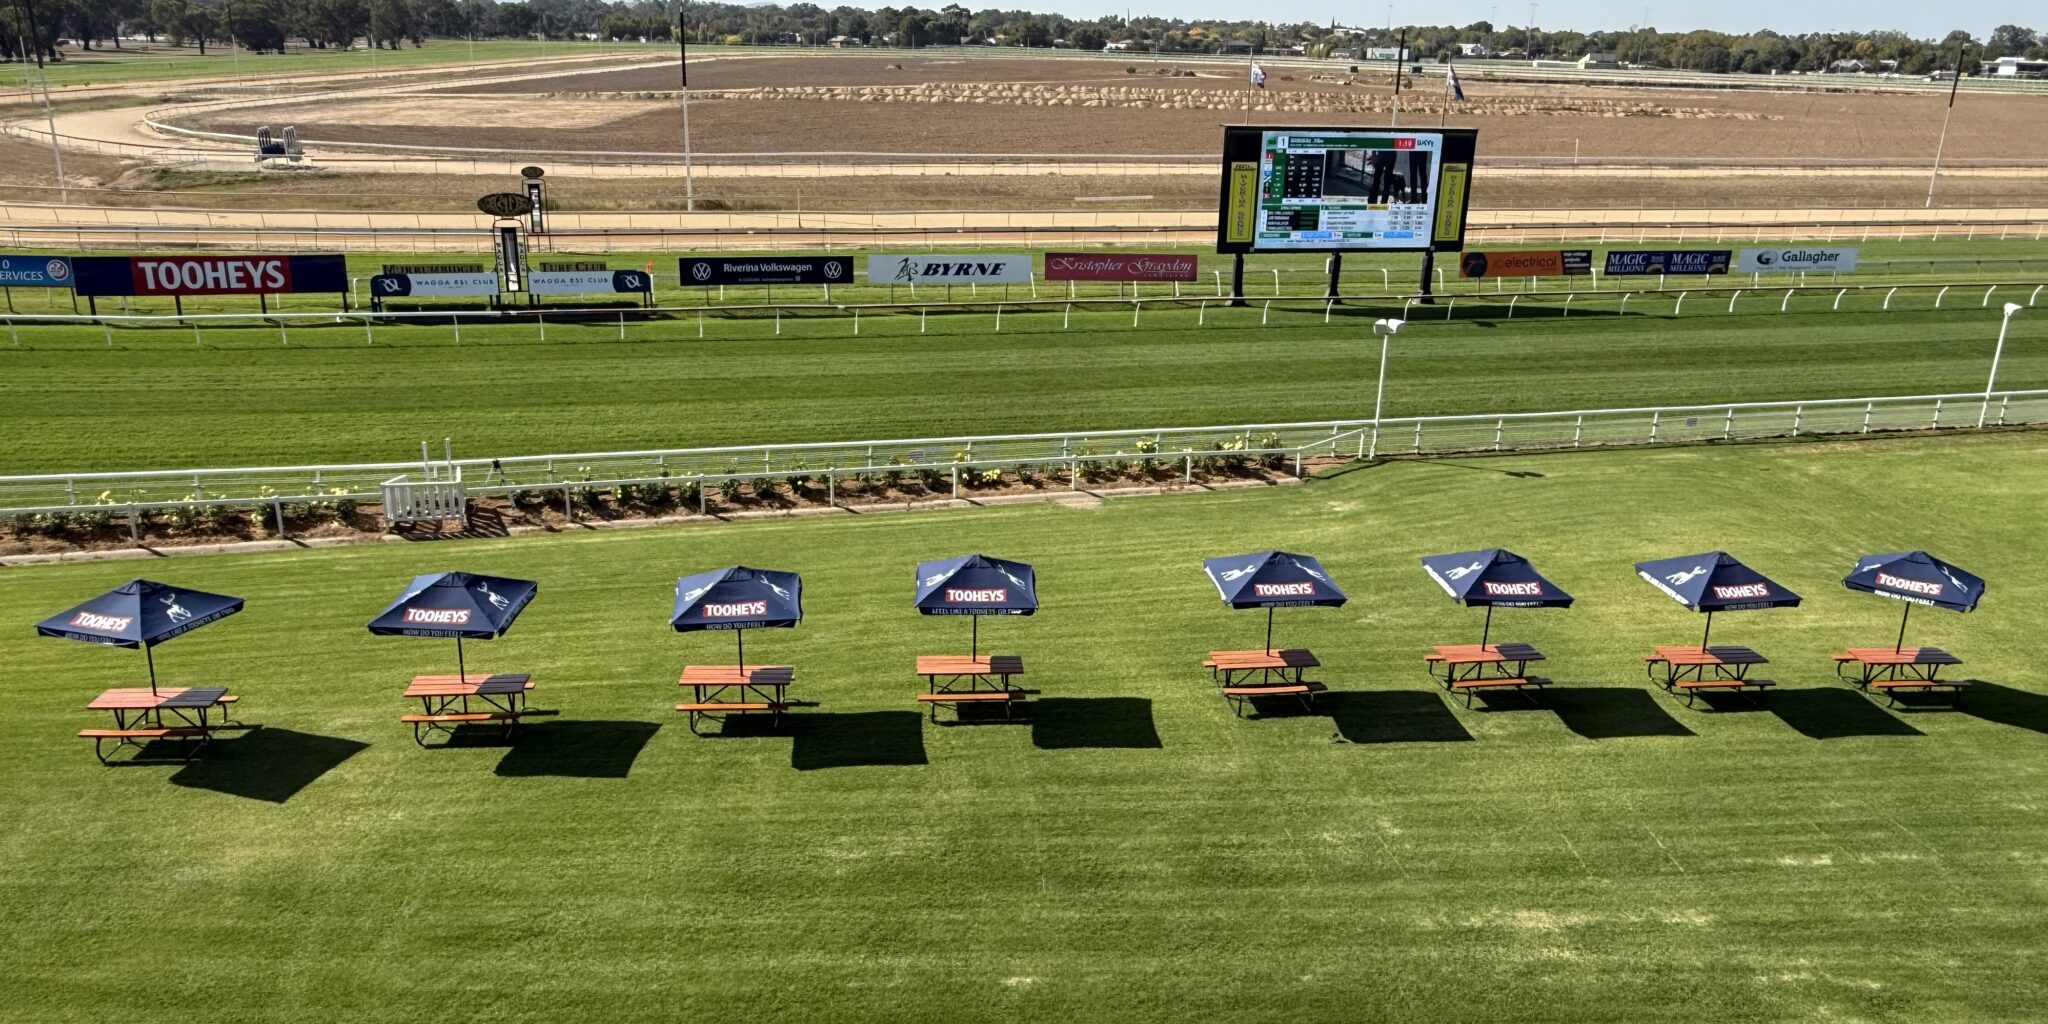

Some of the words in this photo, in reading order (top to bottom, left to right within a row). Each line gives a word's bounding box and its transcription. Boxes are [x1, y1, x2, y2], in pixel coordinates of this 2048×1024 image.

[1608, 254, 1648, 265] MAGIC
[1671, 253, 1710, 264] MAGIC
[1782, 250, 1840, 264] Gallagher
[723, 264, 758, 272] Riverina
[760, 263, 812, 273] Volkswagen
[921, 262, 1006, 276] BYRNE
[1051, 257, 1125, 274] Kristopher
[1128, 257, 1192, 274] Graydon
[1608, 264, 1646, 272] MILLIONS
[1669, 264, 1707, 272] MILLIONS
[138, 260, 285, 290] TOOHEYS
[1256, 584, 1312, 595] TOOHEYS
[1487, 582, 1540, 595] TOOHEYS
[1880, 573, 1940, 594] TOOHEYS
[948, 590, 1004, 602] TOOHEYS
[1715, 584, 1767, 598] TOOHEYS
[408, 608, 468, 623] TOOHEYS
[705, 602, 766, 616] TOOHEYS
[77, 612, 131, 632] TOOHEYS
